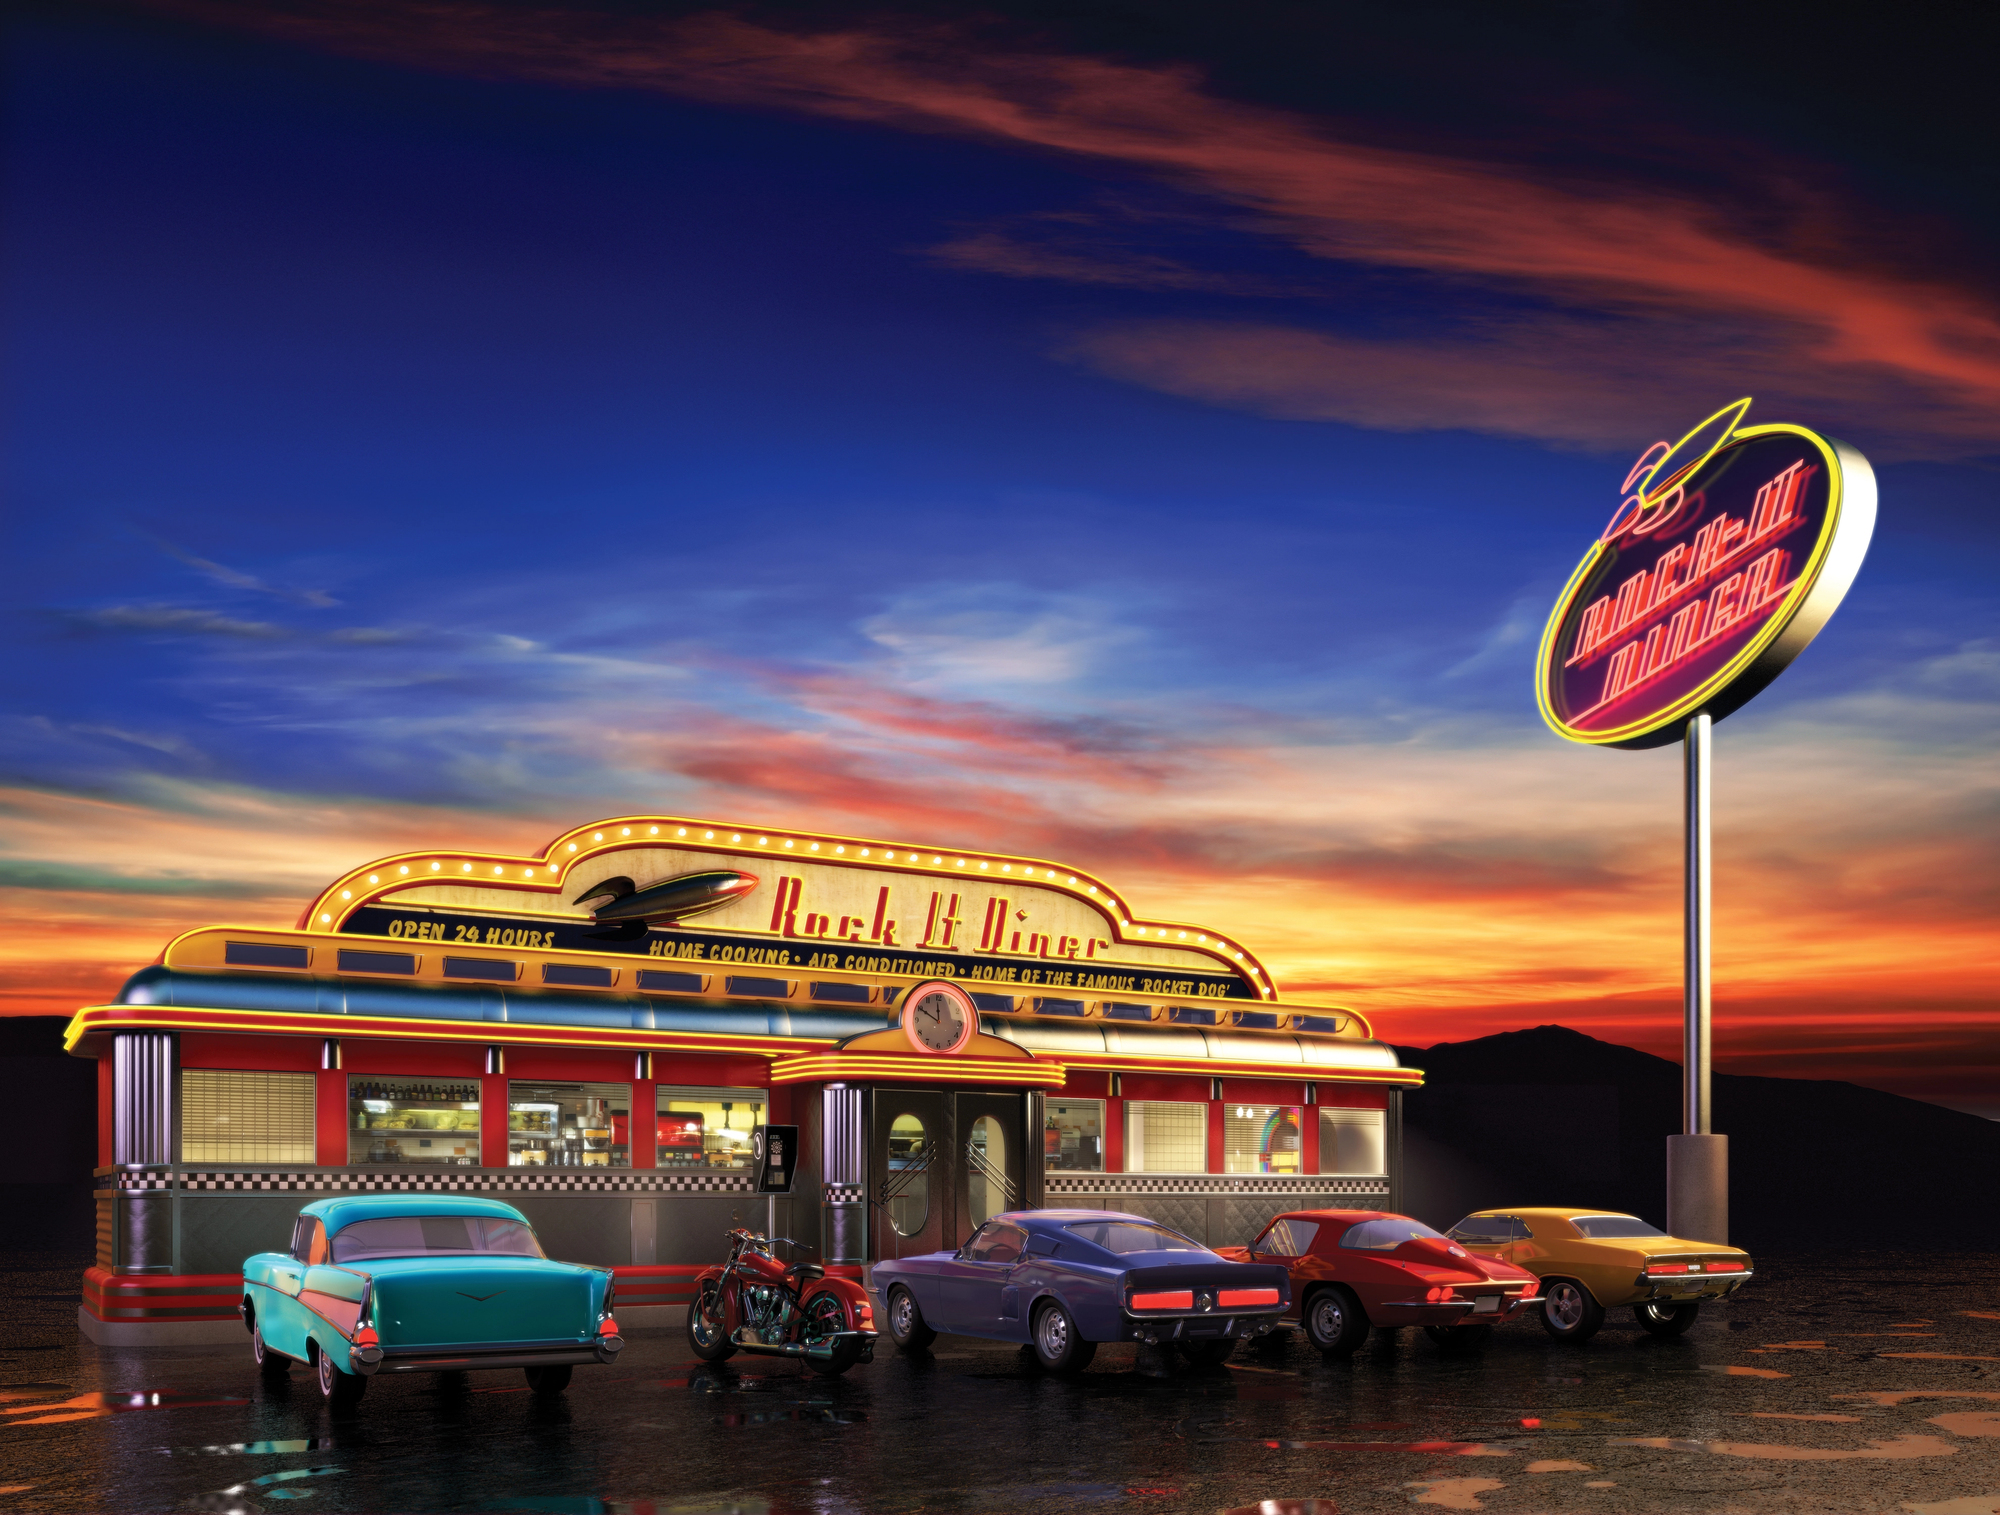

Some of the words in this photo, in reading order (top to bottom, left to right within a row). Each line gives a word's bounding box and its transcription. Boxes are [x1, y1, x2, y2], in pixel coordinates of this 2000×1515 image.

[1590, 547, 1797, 714] DINER
[388, 919, 446, 941] OPEN
[454, 924, 479, 943] 24
[485, 927, 555, 948] HOURS
[769, 875, 901, 946] Rock
[915, 890, 964, 951] It
[974, 896, 1112, 962] Diner
[649, 939, 705, 959] HOME
[709, 944, 790, 965] COOKING
[808, 952, 838, 969] AIR
[844, 954, 956, 977] CONDITIONED
[971, 964, 1017, 982] HOME
[1021, 968, 1041, 984] OF
[1045, 970, 1073, 987] THE
[1077, 972, 1135, 991] FAMOUS
